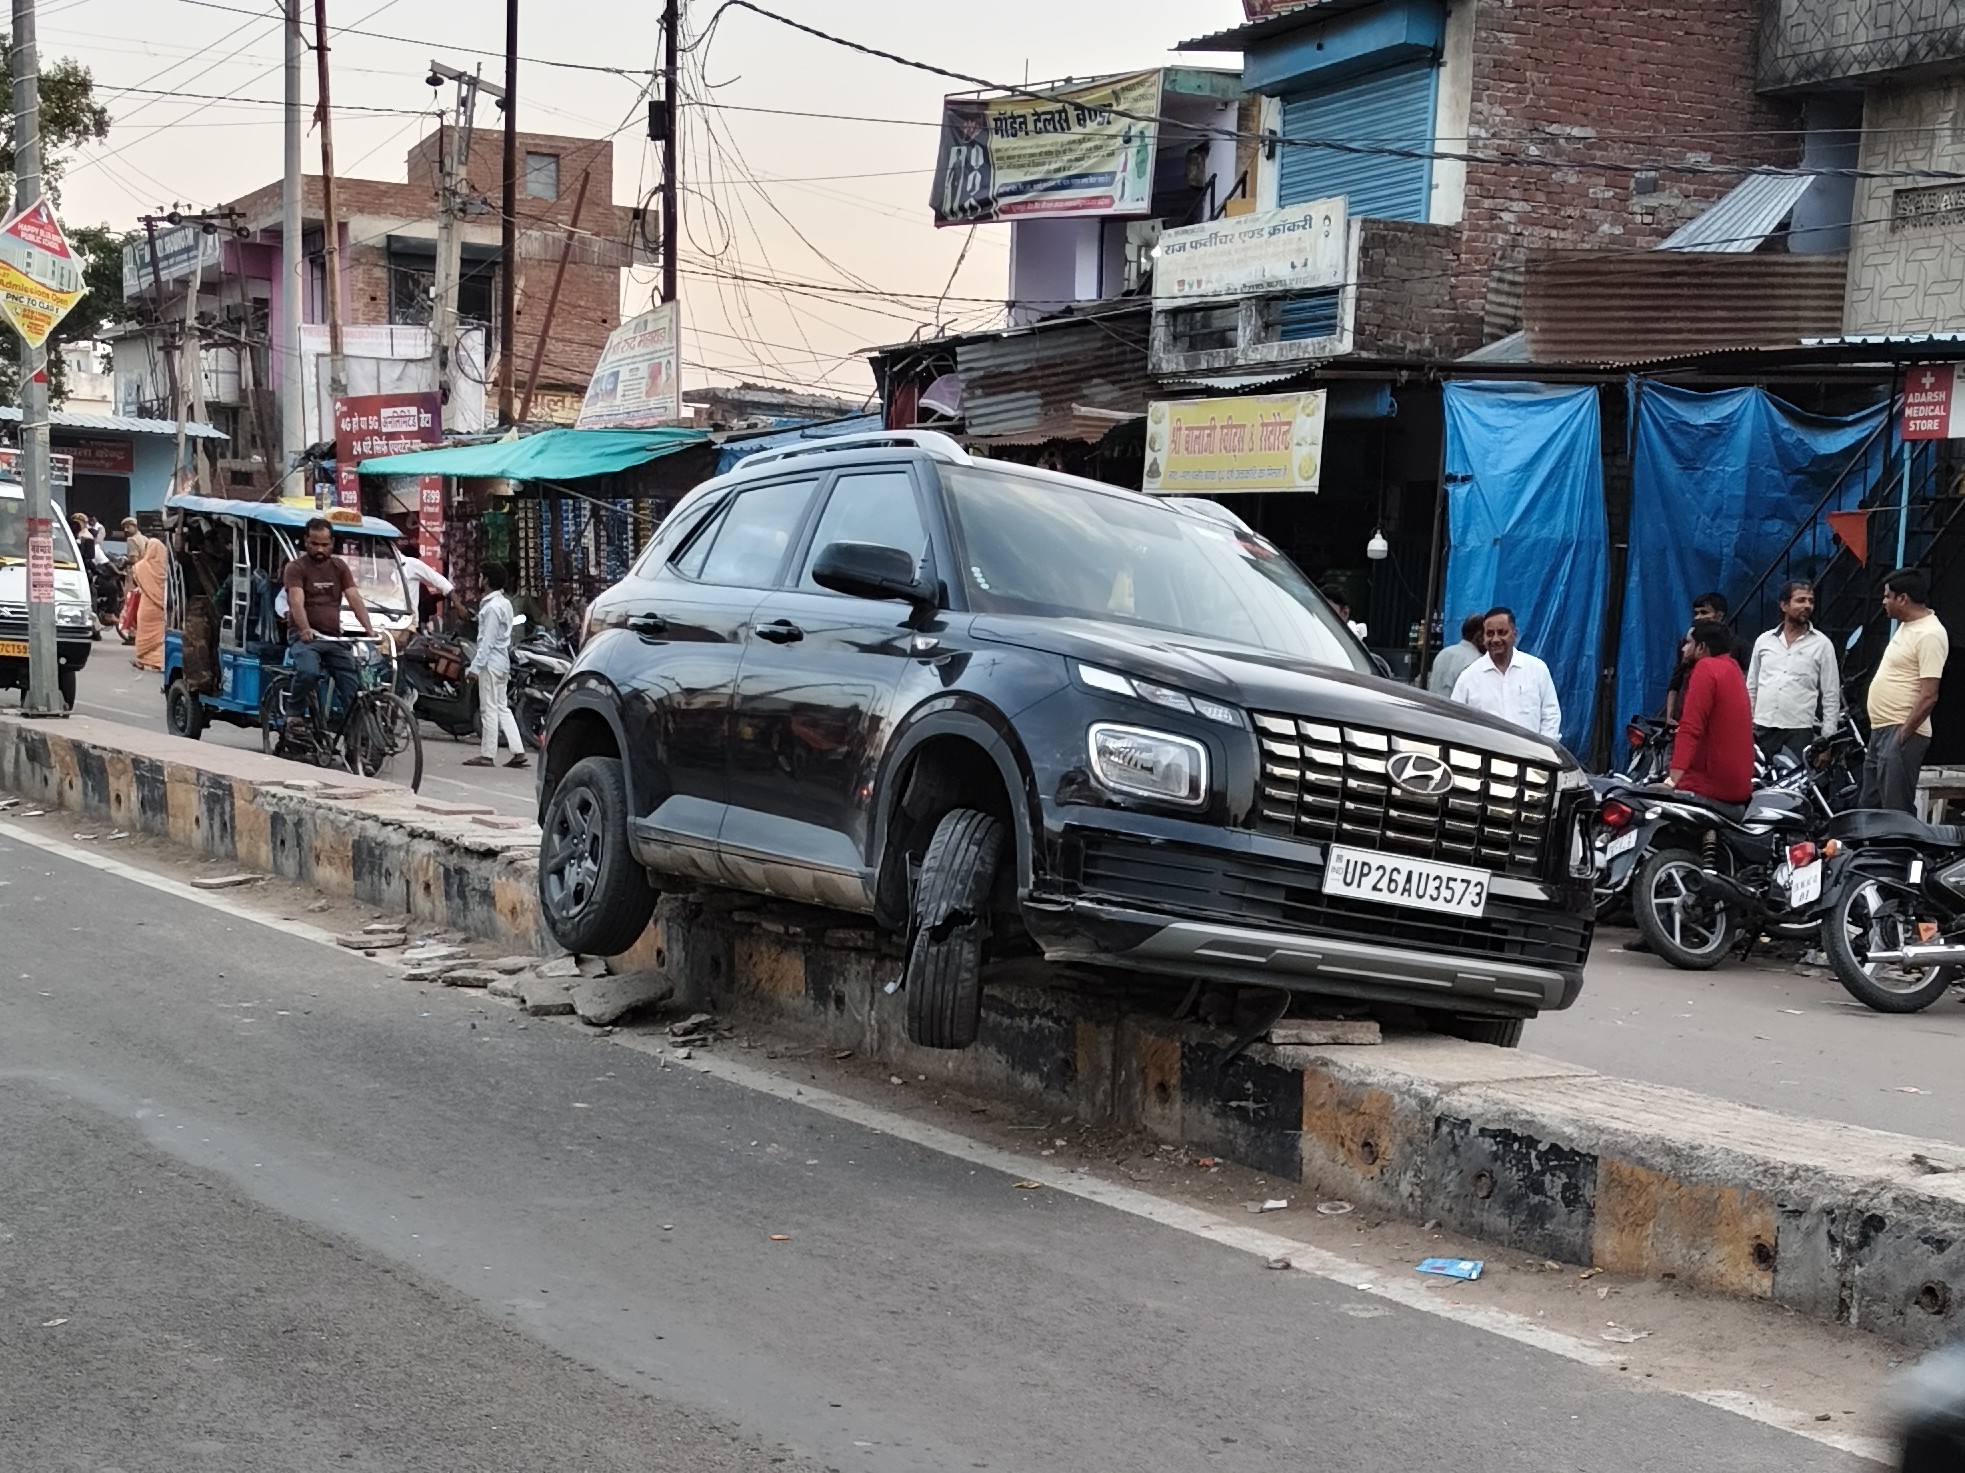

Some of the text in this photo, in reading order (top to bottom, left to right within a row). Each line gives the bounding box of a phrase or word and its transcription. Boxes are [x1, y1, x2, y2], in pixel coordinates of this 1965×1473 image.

[1164, 243, 1186, 255] राज
[1238, 227, 1264, 243] एण्ड
[27, 297, 37, 307] TO
[1907, 391, 1946, 403] ADARSH
[1905, 405, 1946, 417] MEDICAL
[341, 418, 351, 431] 4G
[1909, 419, 1940, 431] STORE
[1171, 416, 1182, 454] श्री
[1184, 416, 1217, 454] बालाजी
[353, 441, 361, 455] 24
[1342, 859, 1484, 907] UP26AU3573
